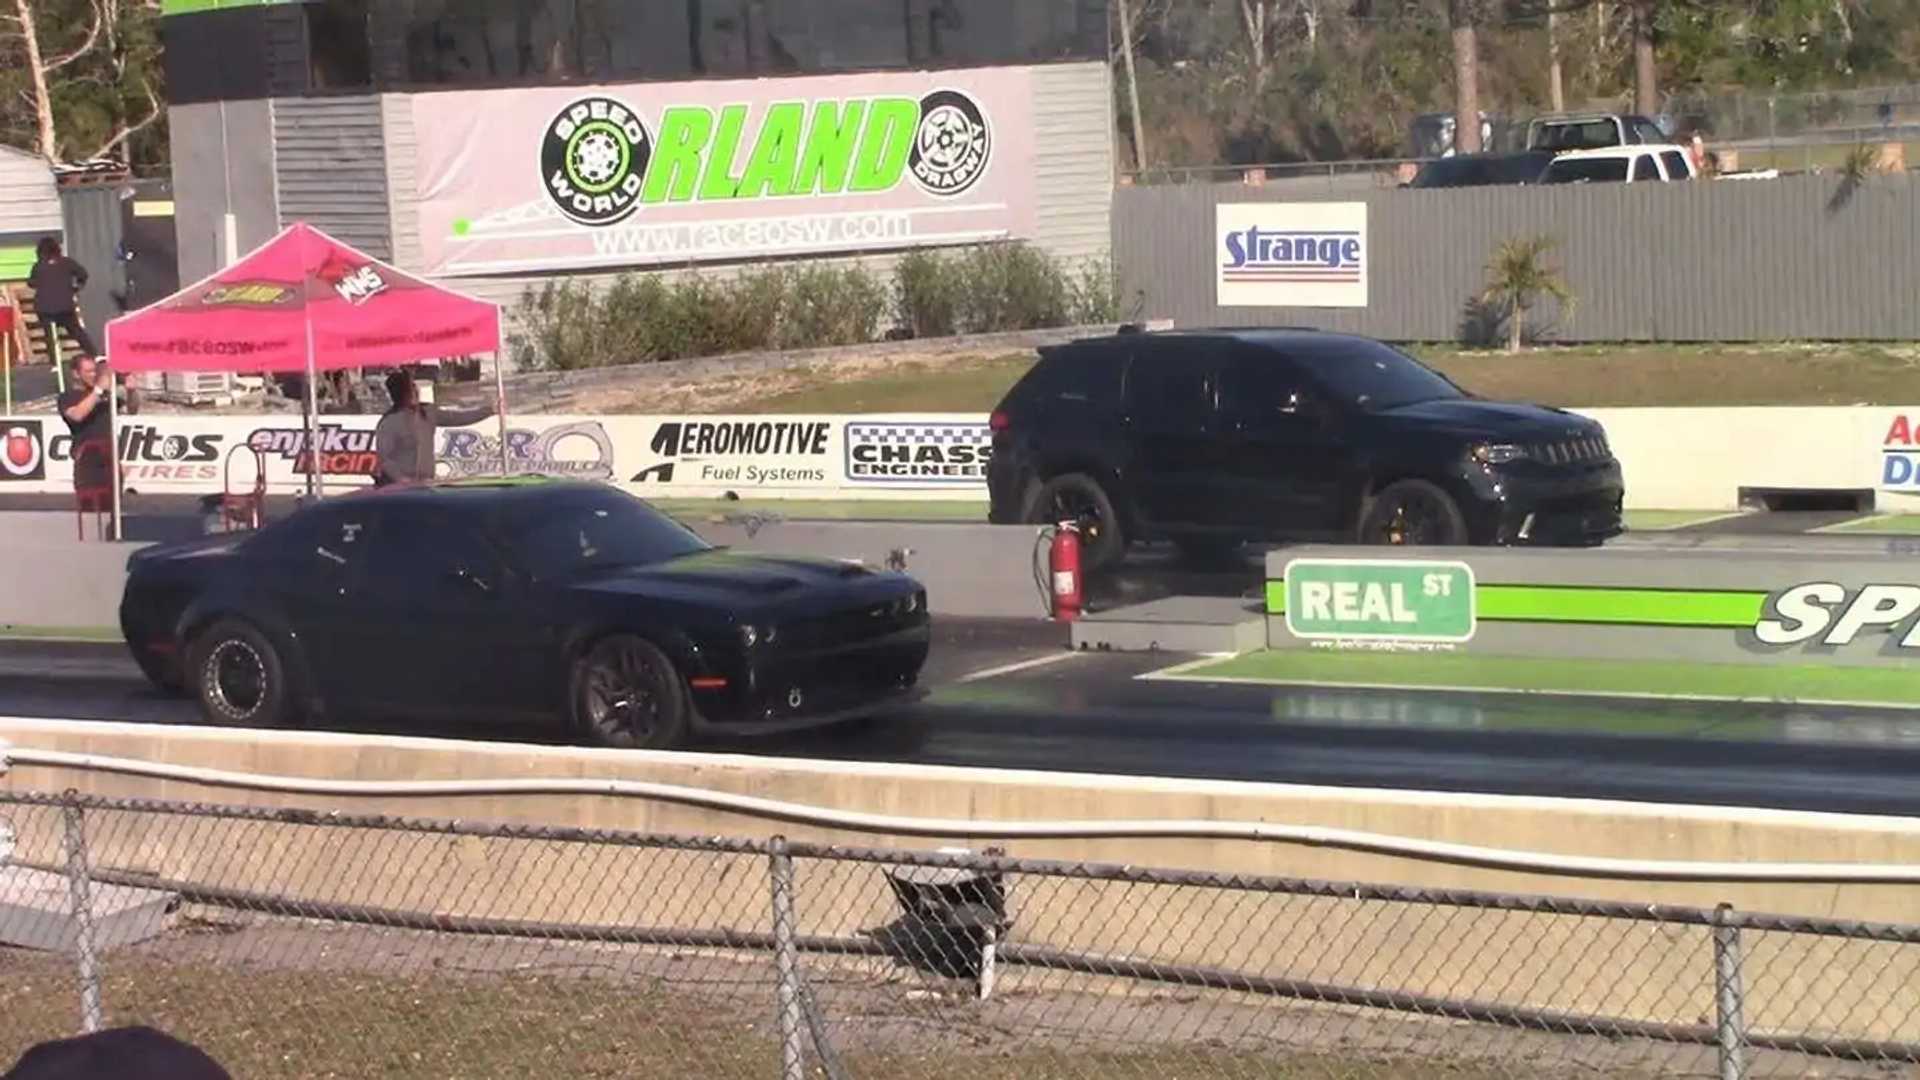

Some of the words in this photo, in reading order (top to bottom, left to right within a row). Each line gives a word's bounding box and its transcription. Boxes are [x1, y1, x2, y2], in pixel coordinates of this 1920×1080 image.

[554, 101, 644, 145] SPEED
[914, 121, 984, 188] DRAGWAY
[551, 169, 642, 214] WORLD
[1225, 224, 1361, 268] Strange
[48, 425, 223, 461] clitos
[651, 422, 830, 456] AEROMOTIVE
[121, 465, 217, 479] TIRES
[701, 464, 741, 481] Fuel
[746, 464, 825, 484] Systems
[1301, 581, 1418, 623] REAL
[1422, 574, 1453, 597] ST
[1755, 581, 1920, 647] SP
